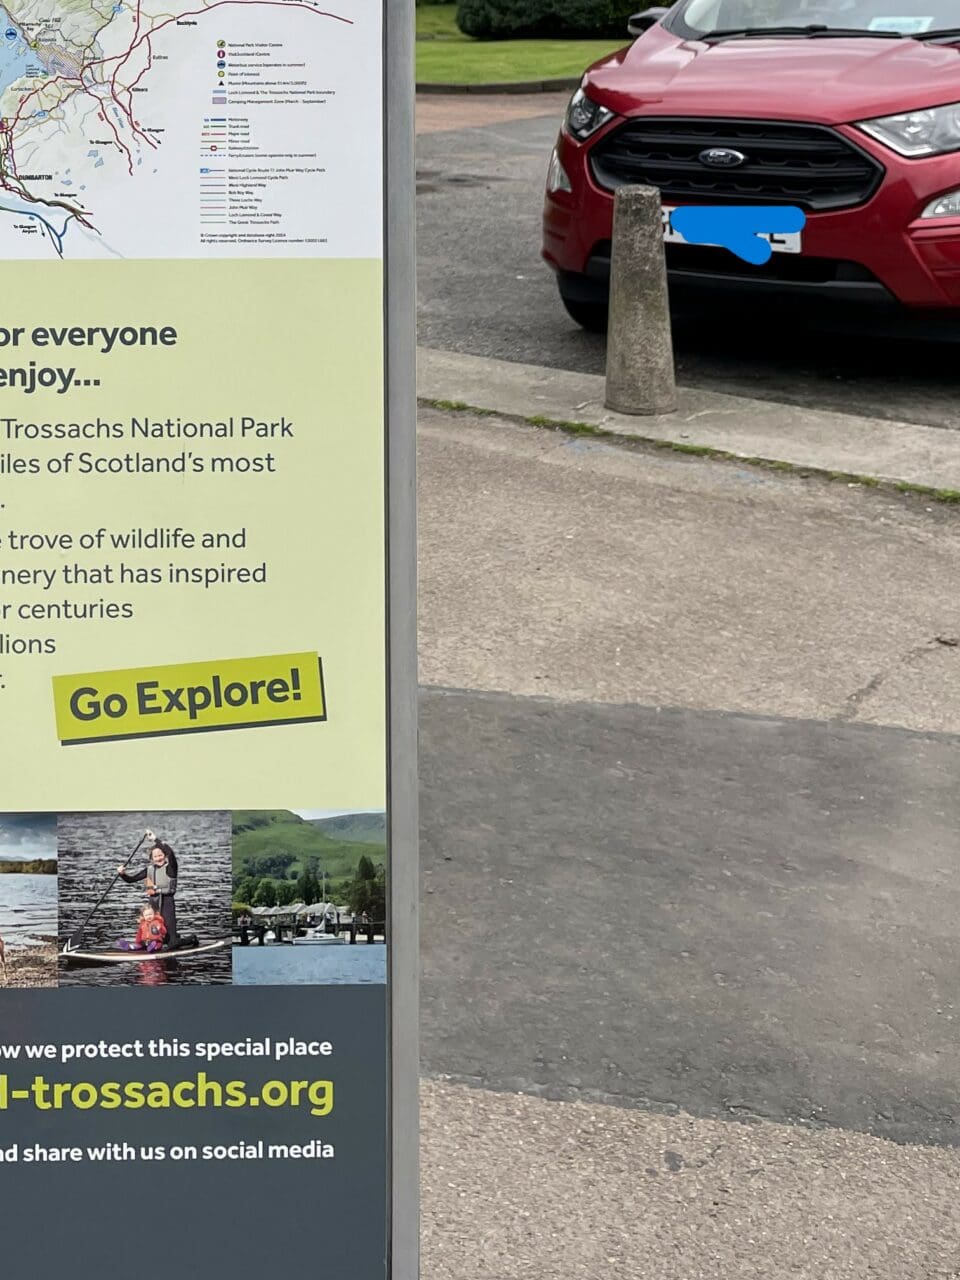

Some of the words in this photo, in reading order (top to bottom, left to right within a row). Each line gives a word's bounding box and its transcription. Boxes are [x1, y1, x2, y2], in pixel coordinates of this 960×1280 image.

[32, 327, 177, 353] everyone
[0, 418, 123, 438] Trossachs
[132, 418, 233, 437] National
[242, 417, 293, 437] Park
[47, 453, 74, 473] of
[79, 452, 203, 473] Scotland's
[212, 453, 275, 472] most
[8, 531, 72, 549] trove
[80, 529, 105, 549] of
[111, 528, 195, 548] wildlife
[202, 528, 245, 548] and
[63, 564, 114, 584] that
[121, 563, 161, 583] has
[170, 563, 265, 588] inspired
[18, 599, 133, 619] centuries
[70, 687, 128, 720] Go
[136, 668, 301, 720] Explore!
[25, 1045, 56, 1058] we
[62, 1040, 144, 1062] protect
[148, 1039, 190, 1057] this
[196, 1038, 270, 1060] special
[276, 1038, 332, 1060] place
[23, 1144, 82, 1161] share
[87, 1143, 135, 1160] with
[141, 1147, 165, 1160] us
[170, 1147, 196, 1159] on
[203, 1141, 262, 1159] social
[269, 1140, 334, 1158] media
